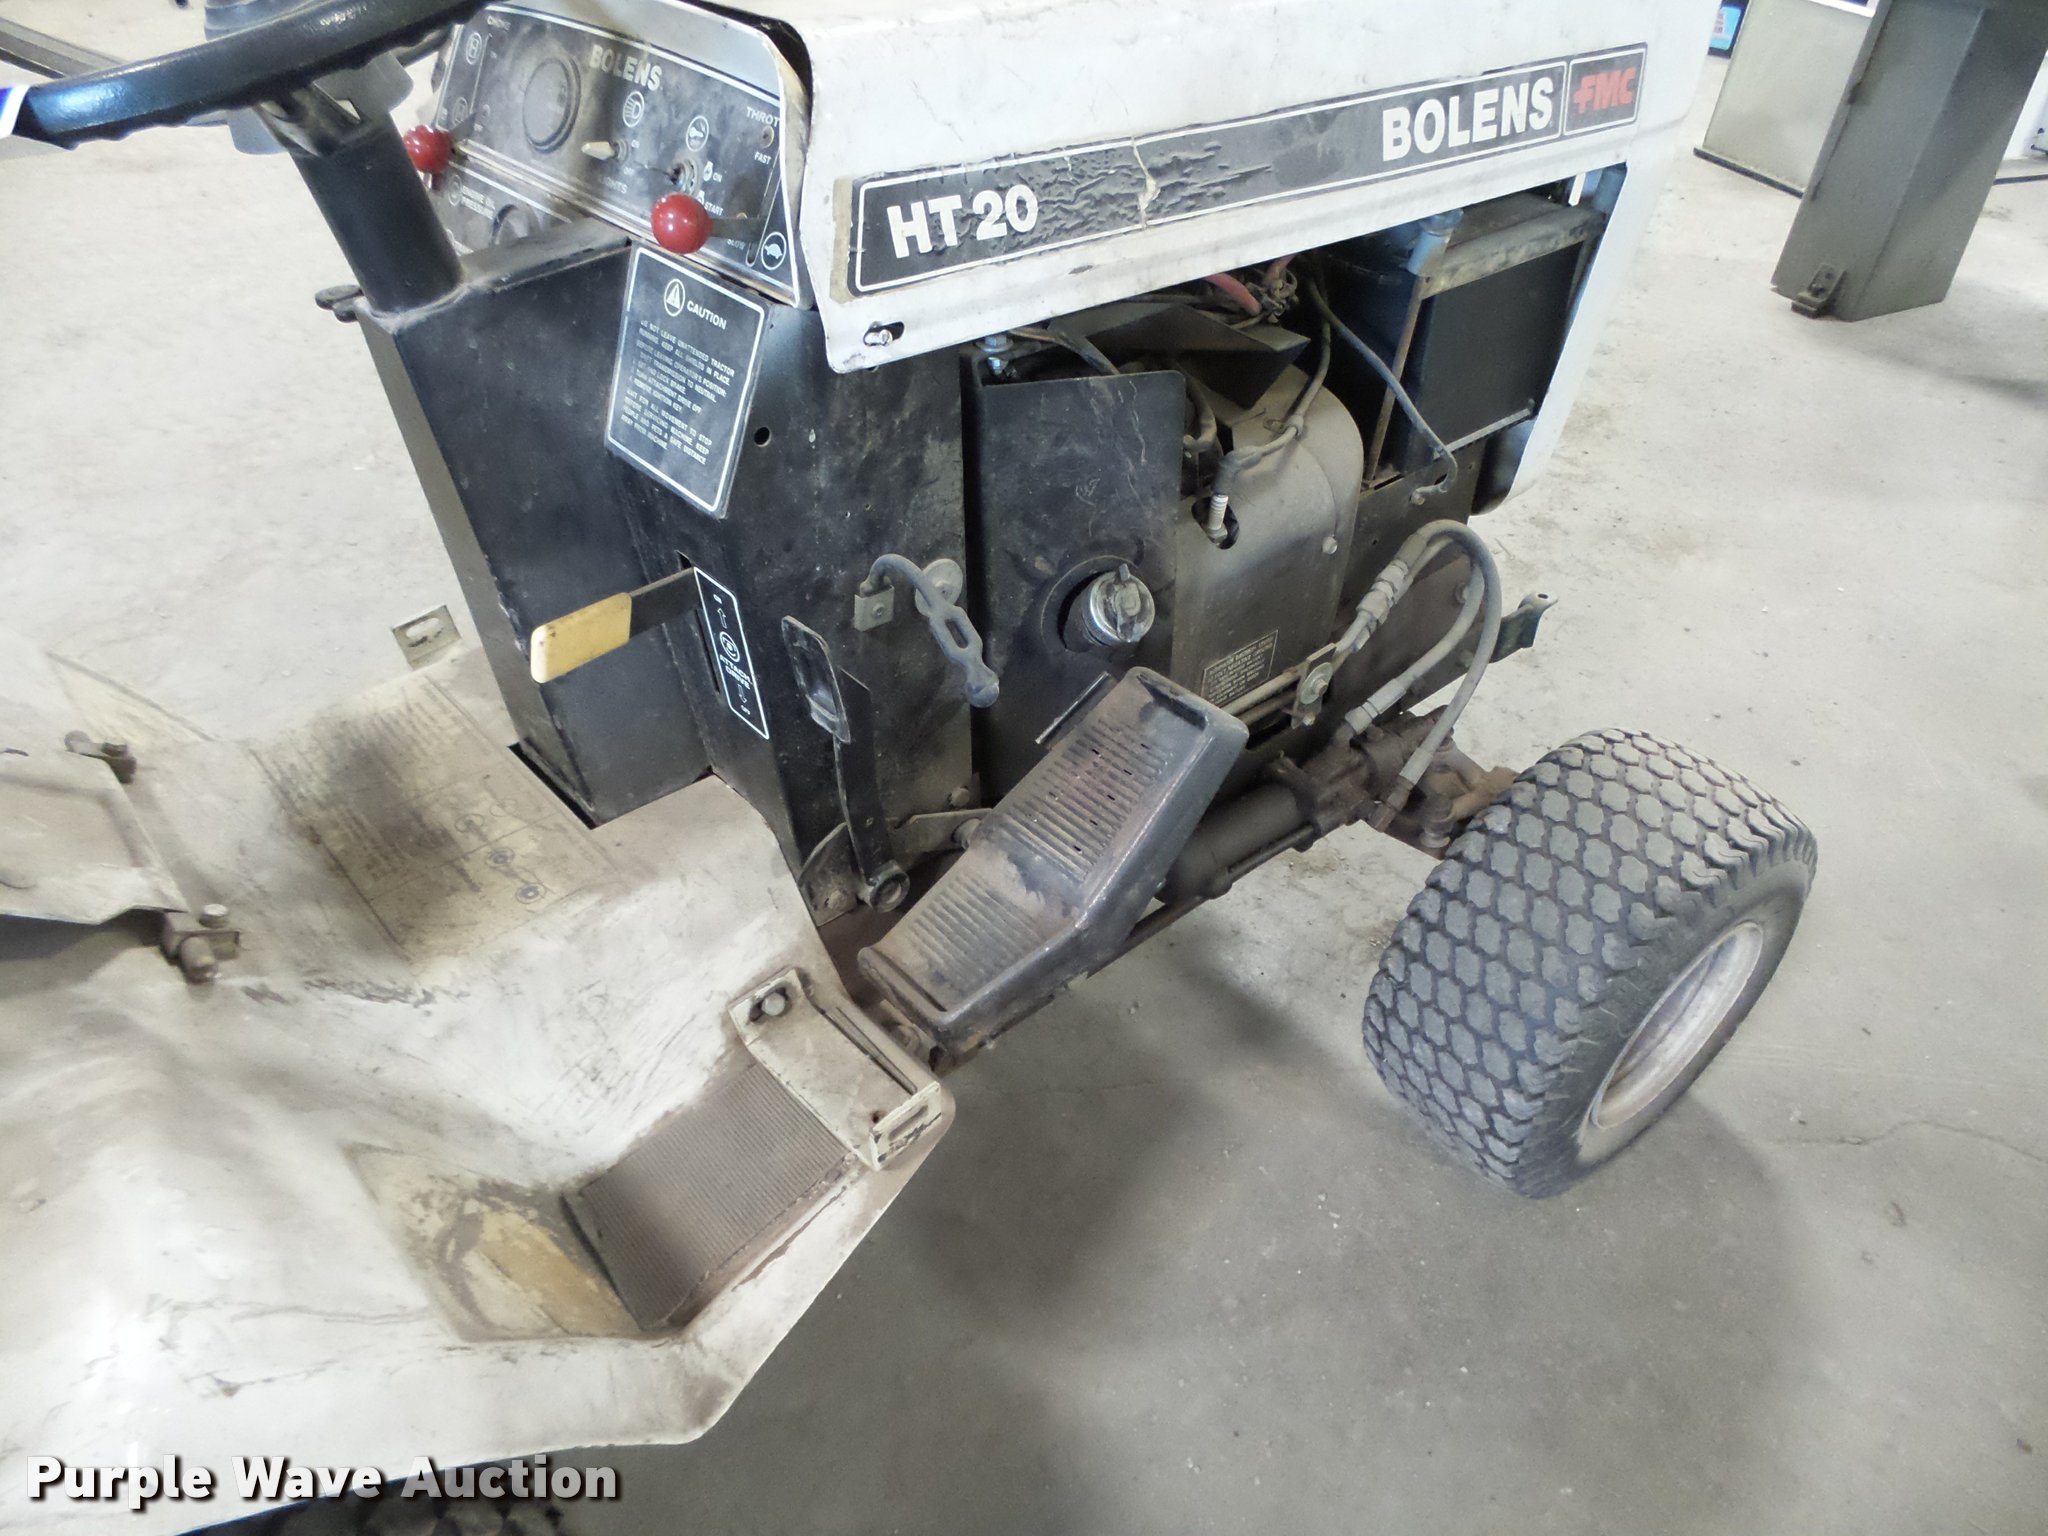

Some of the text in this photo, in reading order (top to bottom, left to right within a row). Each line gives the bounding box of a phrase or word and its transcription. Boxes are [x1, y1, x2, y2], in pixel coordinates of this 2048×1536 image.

[589, 44, 663, 91] BOLENS
[1573, 67, 1637, 114] FMC
[1382, 77, 1554, 162] BOLENS
[754, 151, 772, 165] FAST
[703, 201, 724, 217] START
[886, 184, 1039, 259] HT 20
[686, 300, 727, 330] CAUTION
[710, 357, 735, 376] TRACTOR
